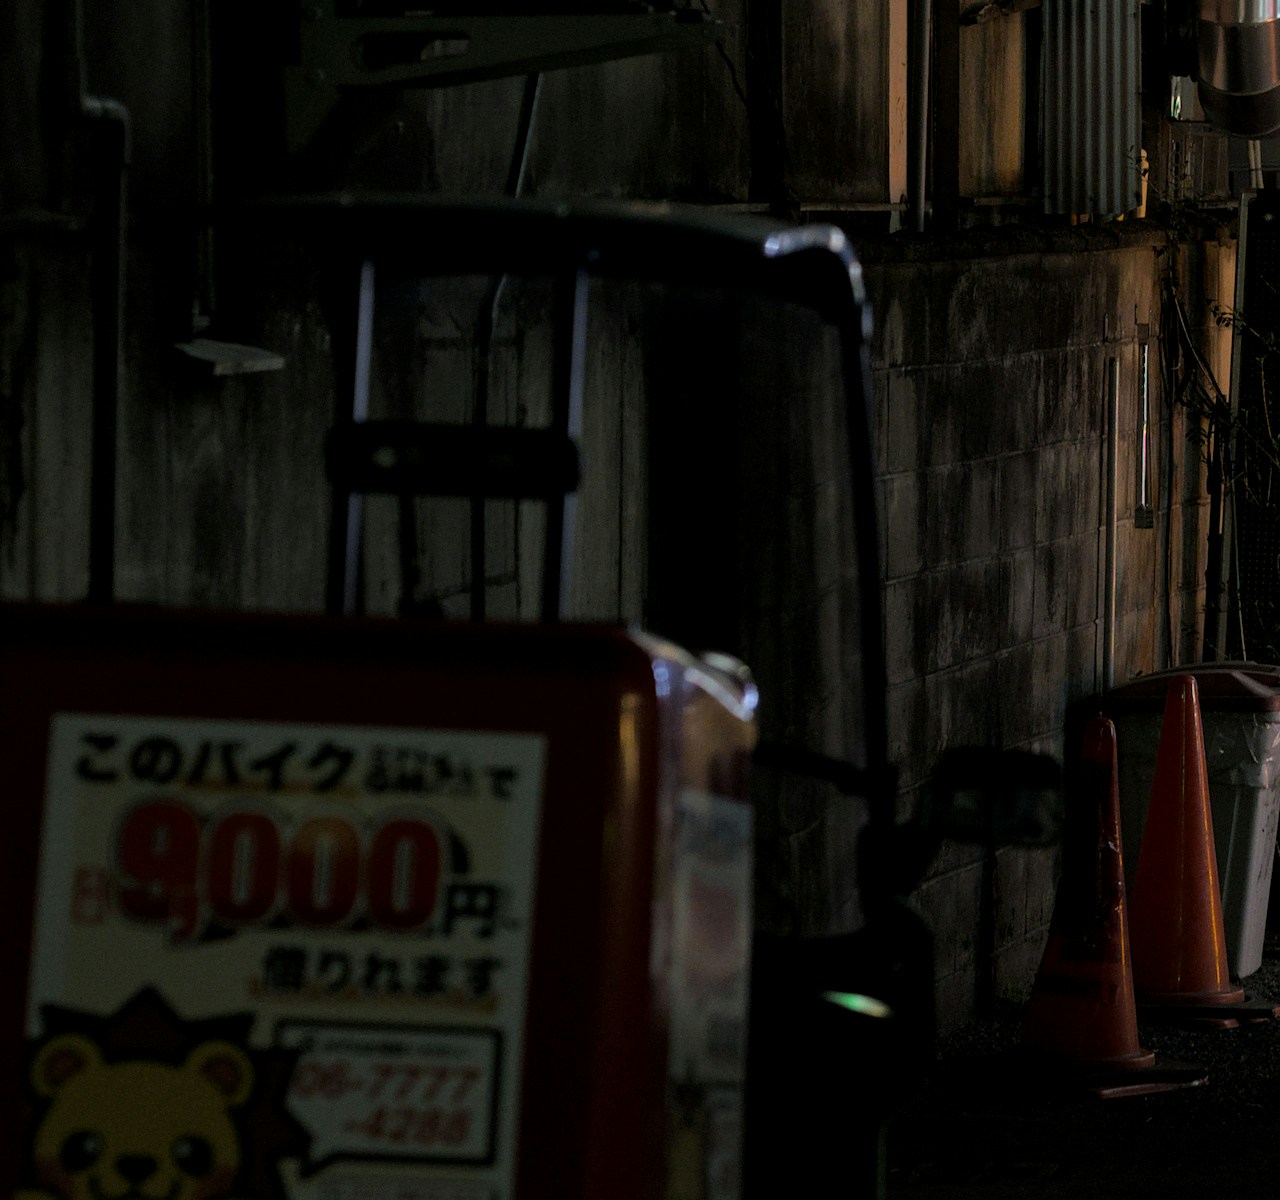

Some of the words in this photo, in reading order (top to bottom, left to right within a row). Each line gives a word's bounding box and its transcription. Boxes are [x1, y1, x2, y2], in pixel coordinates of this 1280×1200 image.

[76, 732, 357, 789] このバイク
[262, 944, 505, 1000] 借りれます
